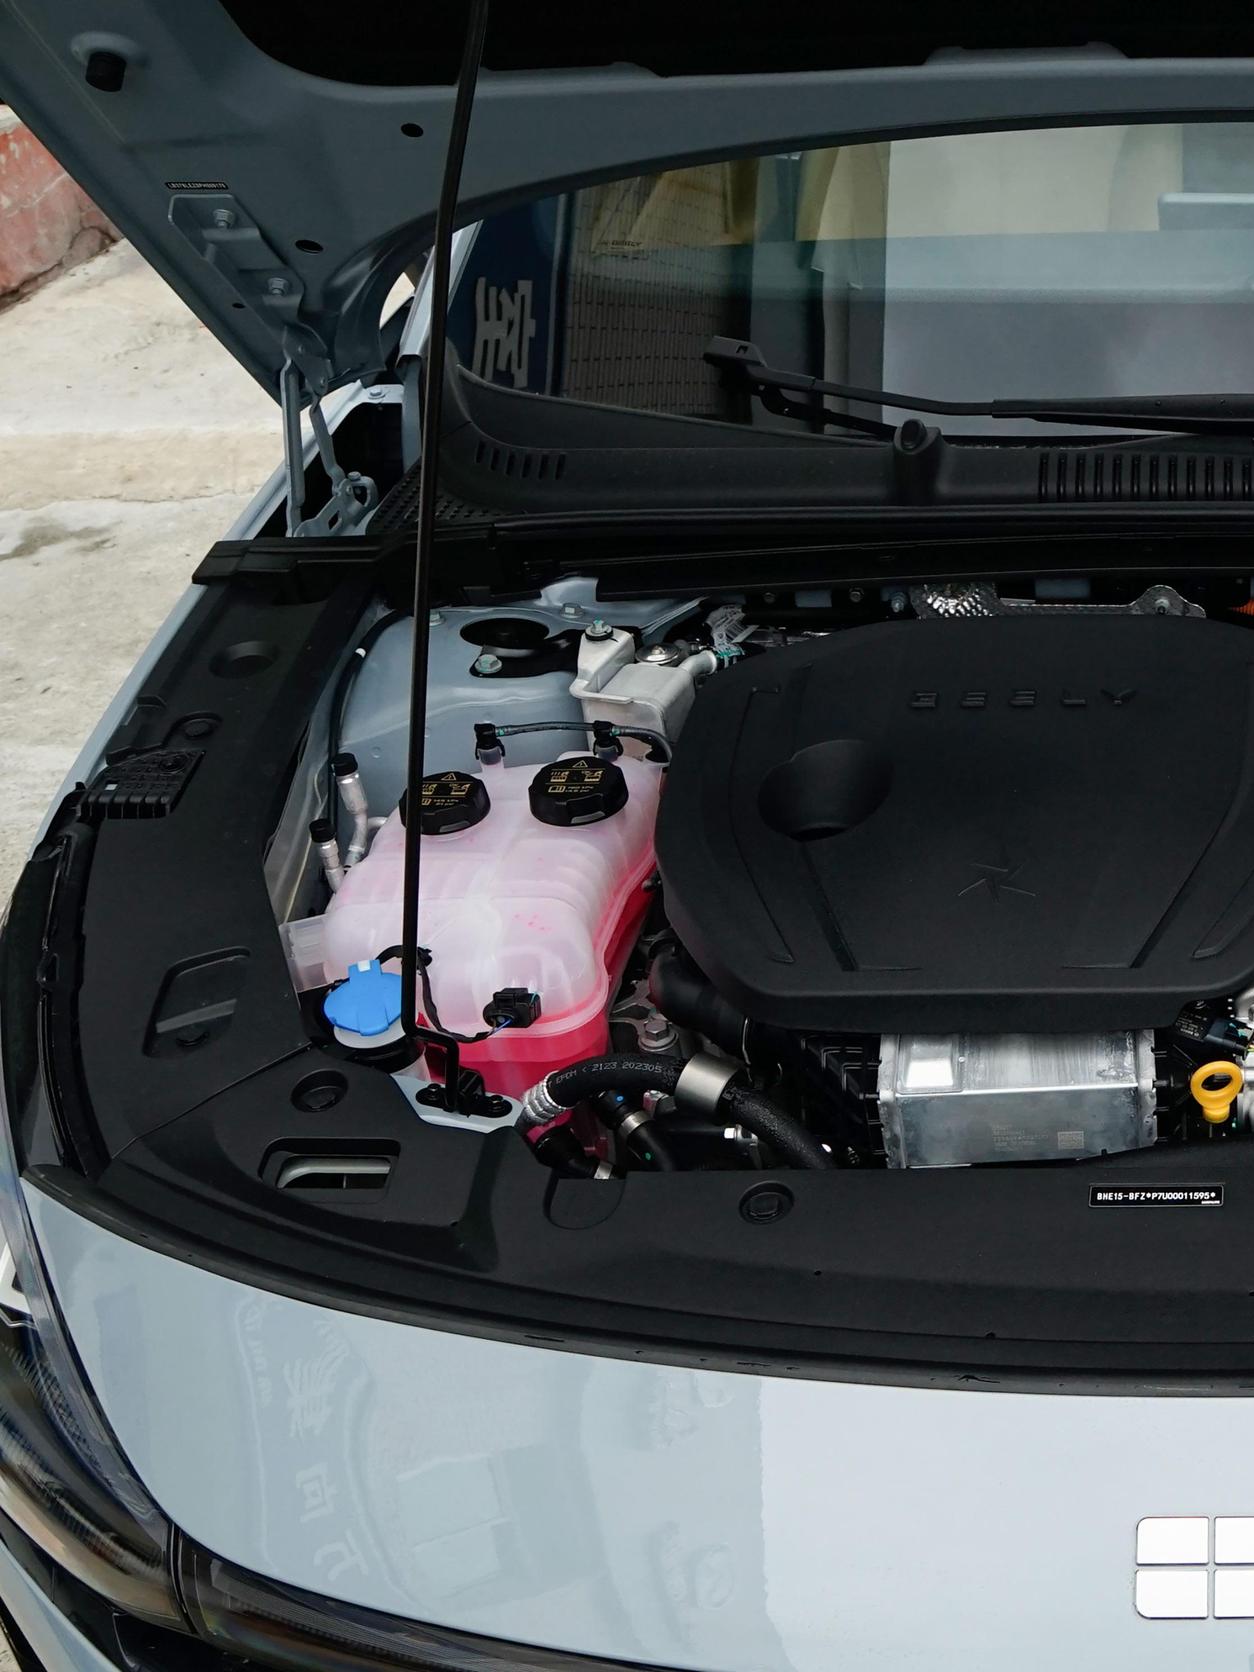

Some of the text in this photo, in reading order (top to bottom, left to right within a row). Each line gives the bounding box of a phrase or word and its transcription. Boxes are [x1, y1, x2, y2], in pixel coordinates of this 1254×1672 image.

[909, 688, 1138, 709] GEELY
[592, 1061, 618, 1072] 2123
[621, 1061, 662, 1074] 202305
